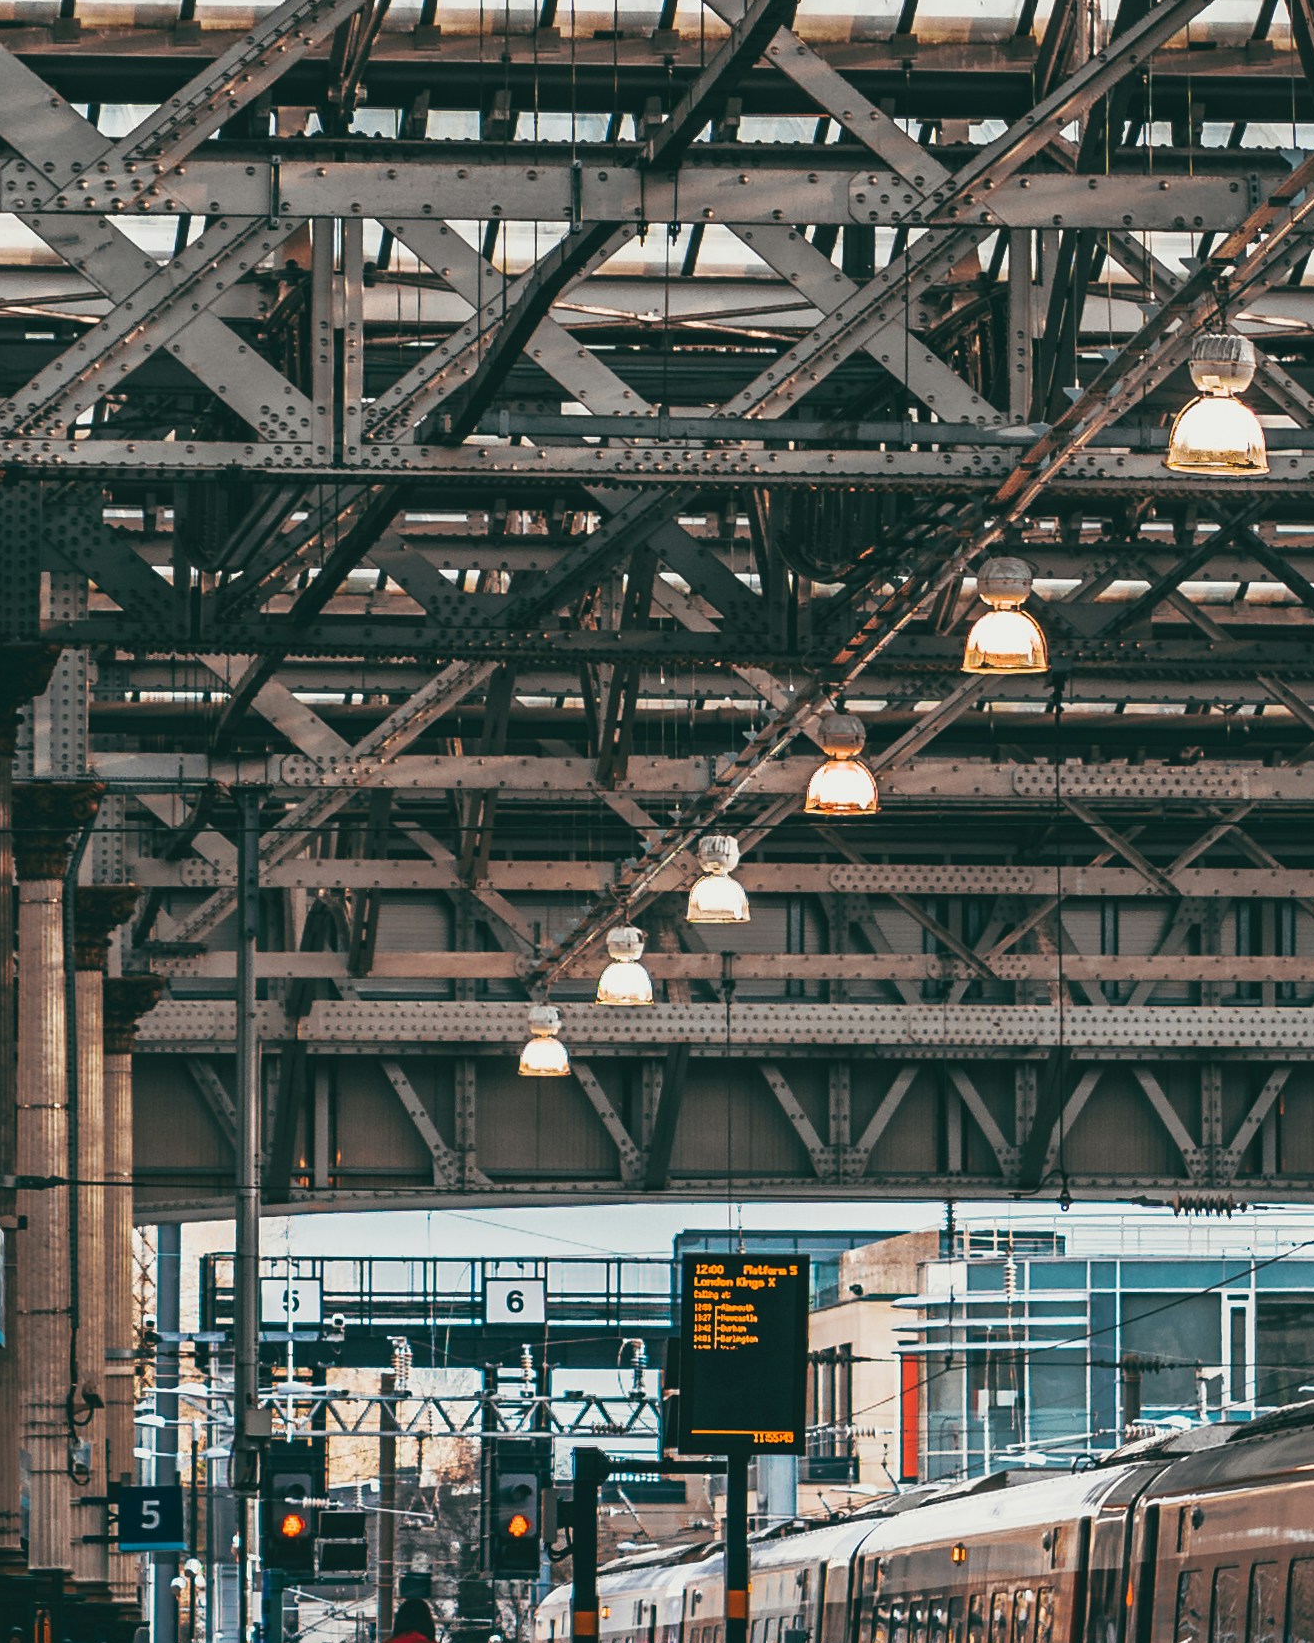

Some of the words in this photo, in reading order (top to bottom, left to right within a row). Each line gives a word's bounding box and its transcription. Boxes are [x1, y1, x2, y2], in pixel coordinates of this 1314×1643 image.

[695, 1264, 725, 1275] 12:00
[743, 1264, 788, 1276] Platform
[693, 1276, 734, 1287] London
[735, 1277, 765, 1290] Kings
[767, 1277, 777, 1288] X
[282, 1289, 300, 1313] 5
[506, 1289, 524, 1314] 6
[141, 1499, 160, 1529] 5
